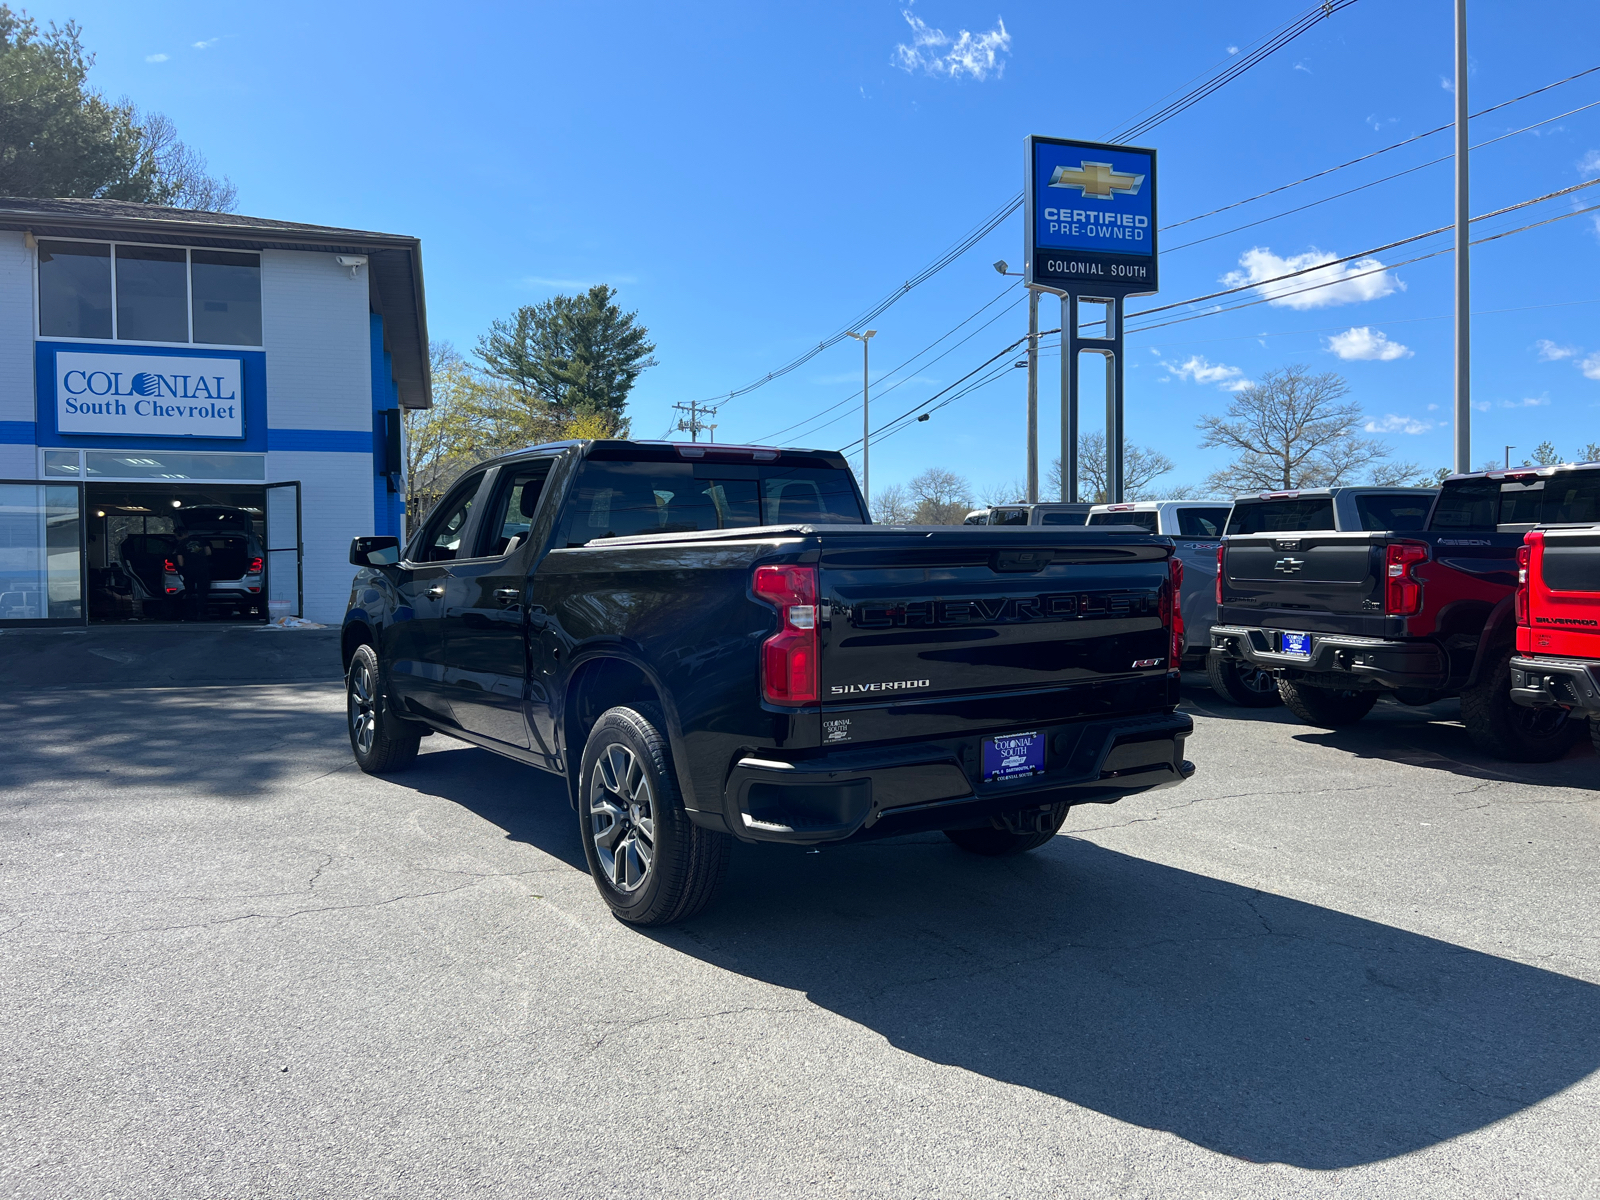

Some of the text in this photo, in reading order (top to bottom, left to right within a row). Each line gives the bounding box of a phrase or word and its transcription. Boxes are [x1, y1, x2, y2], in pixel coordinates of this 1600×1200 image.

[1044, 208, 1148, 228] CERTIFIED
[1050, 222, 1143, 240] PRE-OWNED
[1047, 260, 1146, 277] COLONIAL SOUTH
[63, 370, 235, 400] COLONIAL
[65, 397, 235, 419] South Chevrolet
[856, 594, 1156, 628] CHEVROLET
[1535, 617, 1598, 626] SILVERADO
[1131, 657, 1165, 668] RST
[831, 679, 930, 694] SILVERADO
[823, 719, 852, 728] COLONIAL
[828, 725, 848, 733] SOUTH
[995, 738, 1032, 750] COLONIAL
[1001, 746, 1027, 757] SOUTH
